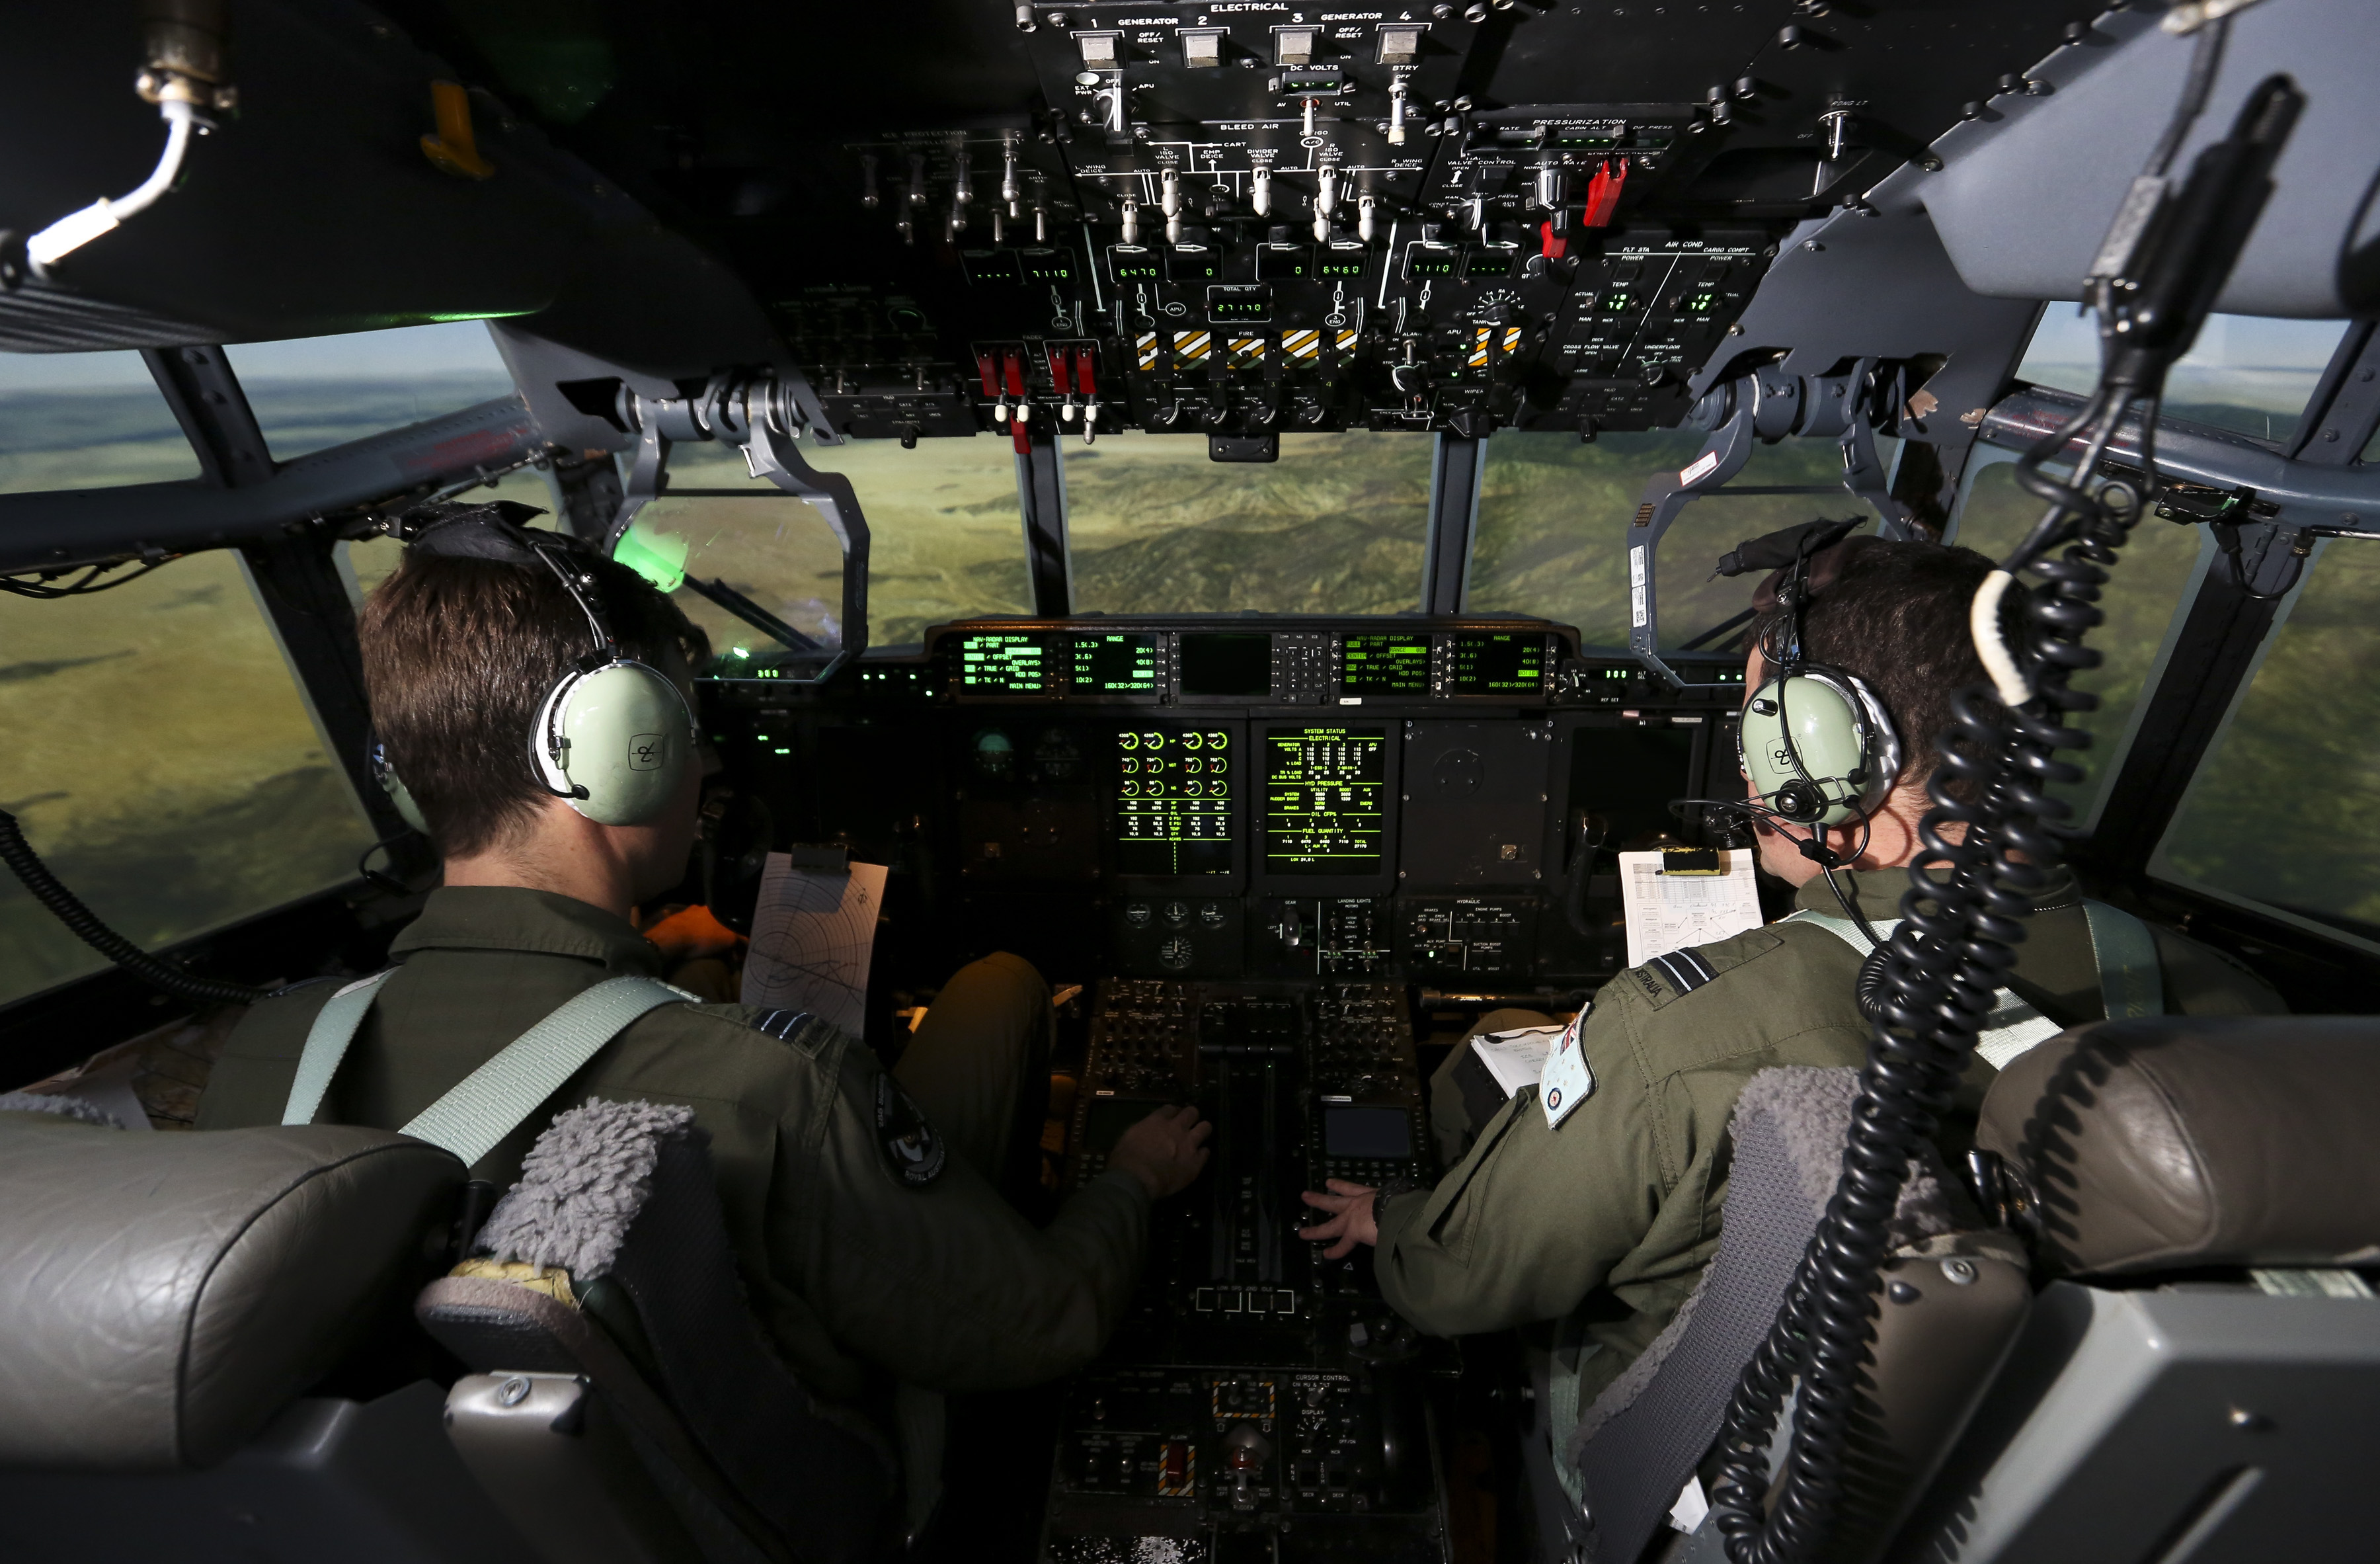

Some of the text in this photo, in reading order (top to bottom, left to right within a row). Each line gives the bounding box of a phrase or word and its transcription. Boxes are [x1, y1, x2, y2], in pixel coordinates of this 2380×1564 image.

[1210, 3, 1289, 13] ELECTRICAL
[1292, 13, 1304, 22] 3
[1320, 12, 1383, 21] GENERATOR
[1399, 11, 1413, 21] 4
[1197, 16, 1208, 26] 2
[1120, 268, 1156, 277] 6470
[1323, 266, 1359, 274] 6460
[1415, 265, 1450, 273] 7110
[1634, 968, 1662, 998] STRALIA
